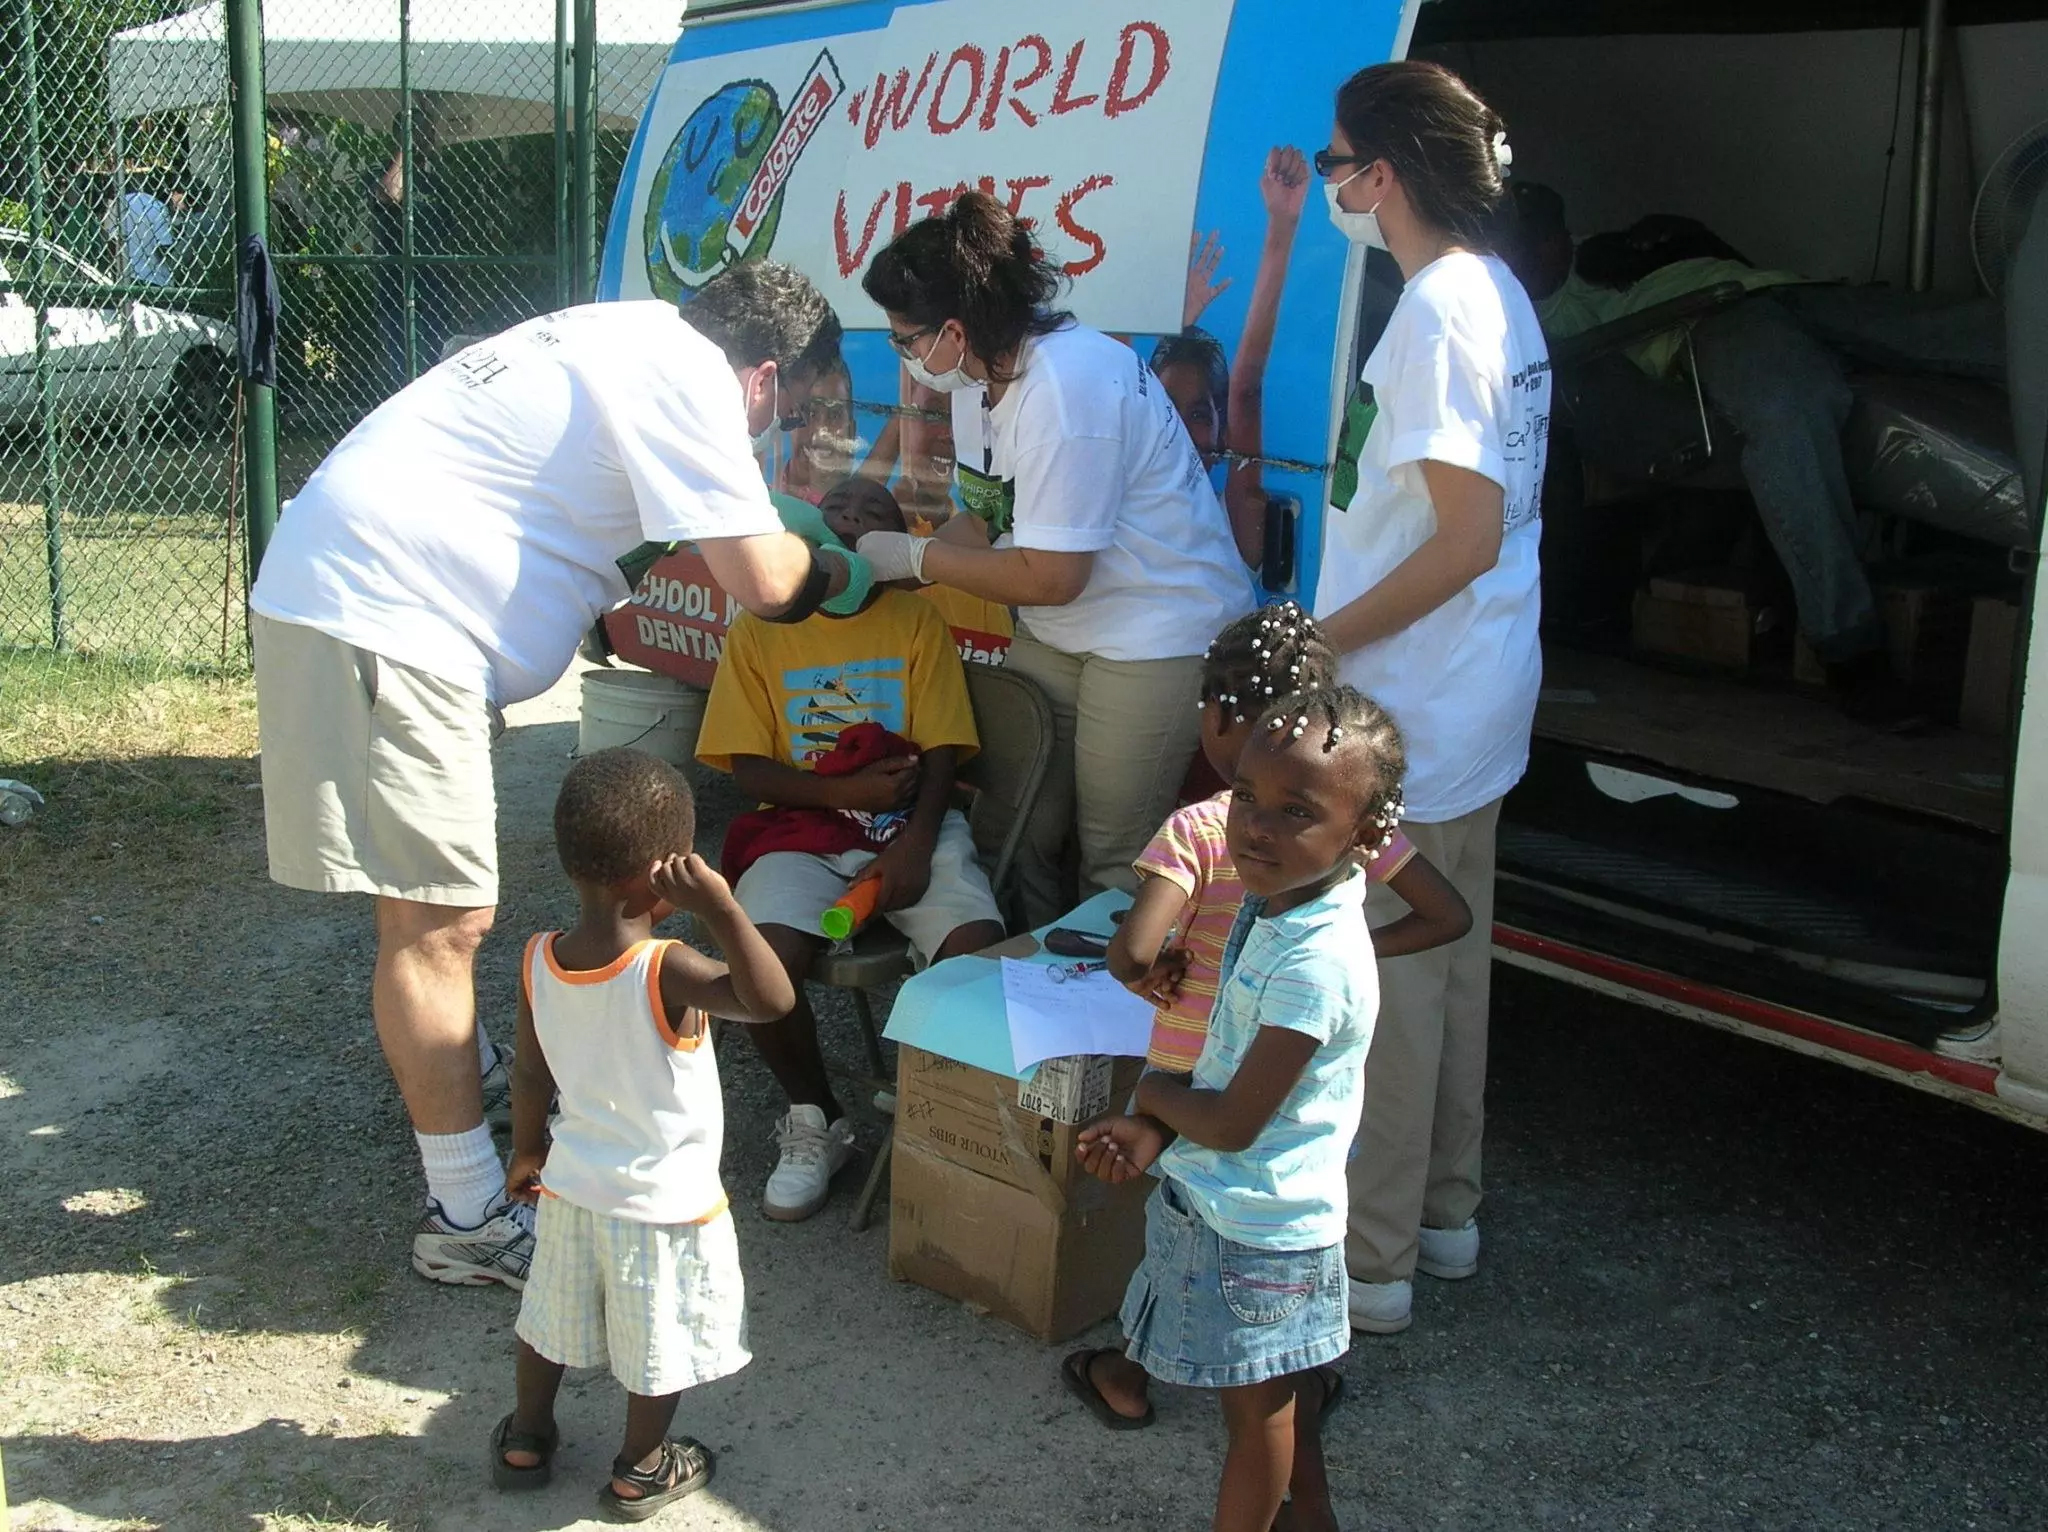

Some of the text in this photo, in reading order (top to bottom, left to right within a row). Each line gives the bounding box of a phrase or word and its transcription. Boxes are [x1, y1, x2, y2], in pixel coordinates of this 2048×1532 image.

[848, 20, 1171, 150] WORLD
[743, 94, 822, 223] Colgate
[631, 575, 718, 622] CHOOL
[928, 1126, 957, 1147] BIBS
